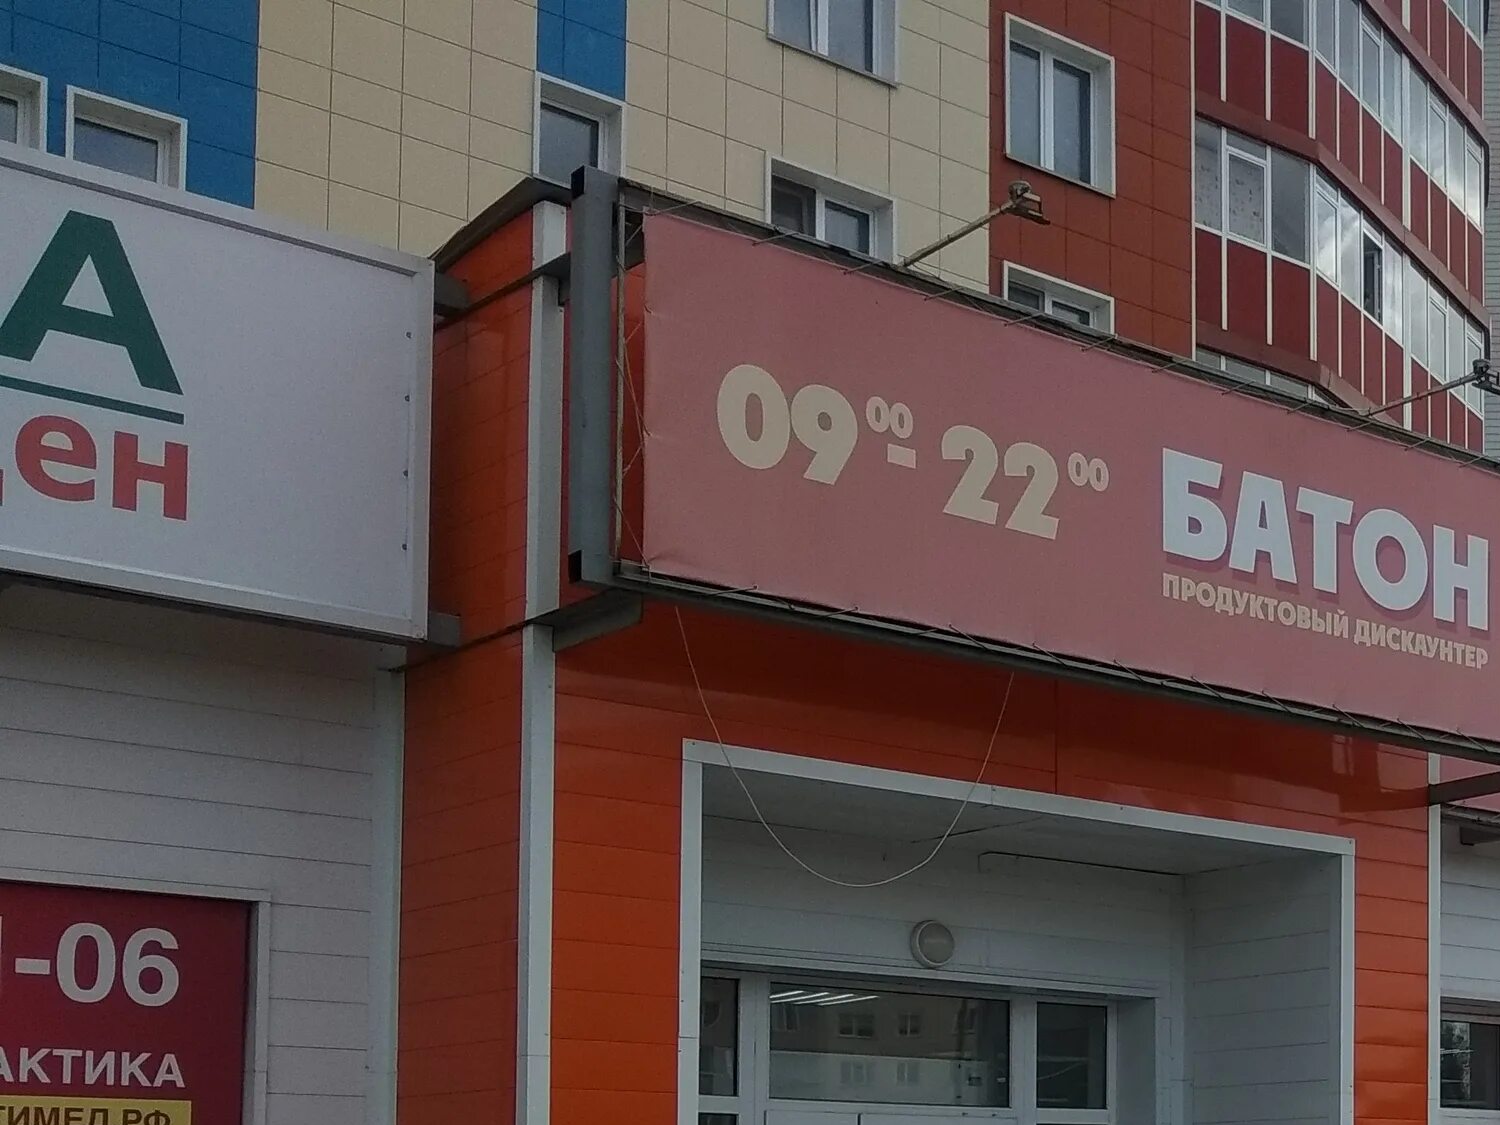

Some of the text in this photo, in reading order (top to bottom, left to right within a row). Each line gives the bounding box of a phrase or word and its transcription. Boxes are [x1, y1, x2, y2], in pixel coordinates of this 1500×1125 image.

[0, 415, 188, 521] ен
[1162, 447, 1489, 631] БАТОН
[1162, 573, 1489, 670] ПРОДУКТОВЫЙ ДИСКАУНТЕР
[0, 915, 180, 1007] -06
